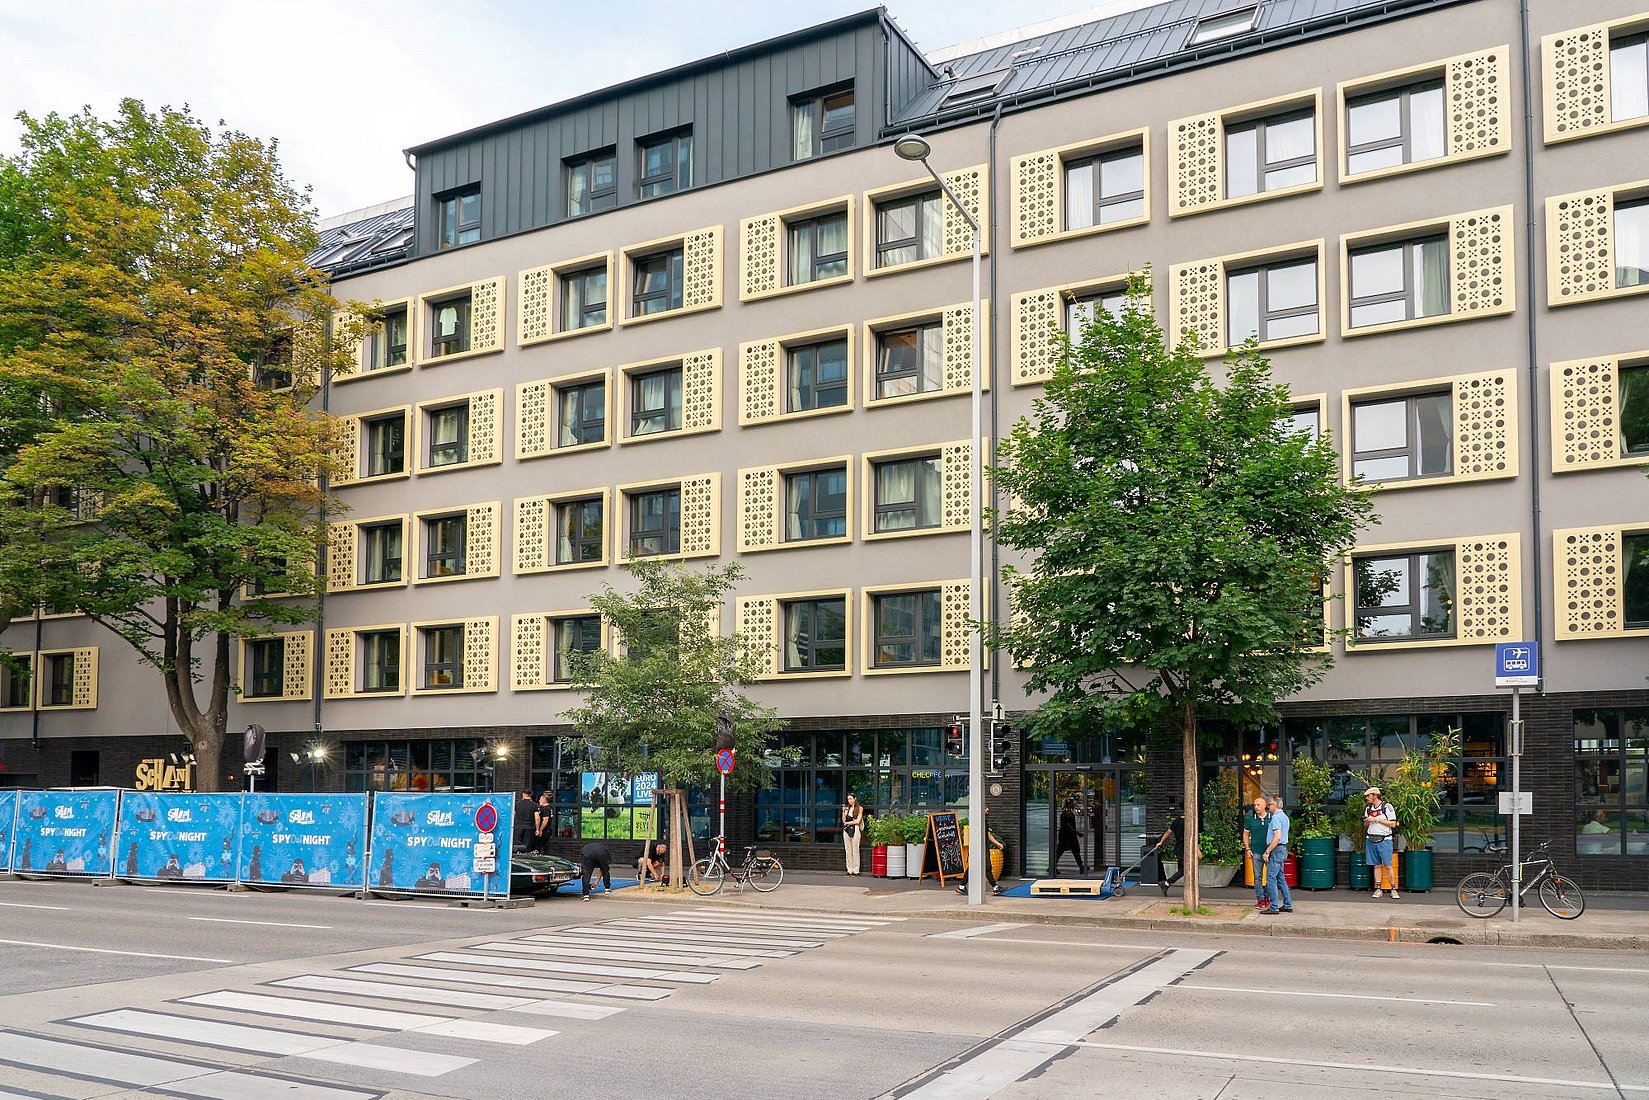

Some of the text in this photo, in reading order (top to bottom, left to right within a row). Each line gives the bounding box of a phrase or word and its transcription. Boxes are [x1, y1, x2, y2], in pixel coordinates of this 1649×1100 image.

[636, 782, 657, 790] 2024
[637, 790, 653, 798] LIVE
[41, 827, 55, 837] SPY
[64, 828, 87, 837] NIGHT
[150, 831, 167, 841] SPY
[178, 832, 207, 842] NIGHT
[272, 833, 291, 844] SPY
[303, 834, 331, 845] NIGHT
[407, 836, 427, 847] SPY
[440, 837, 472, 848] NIGHT
